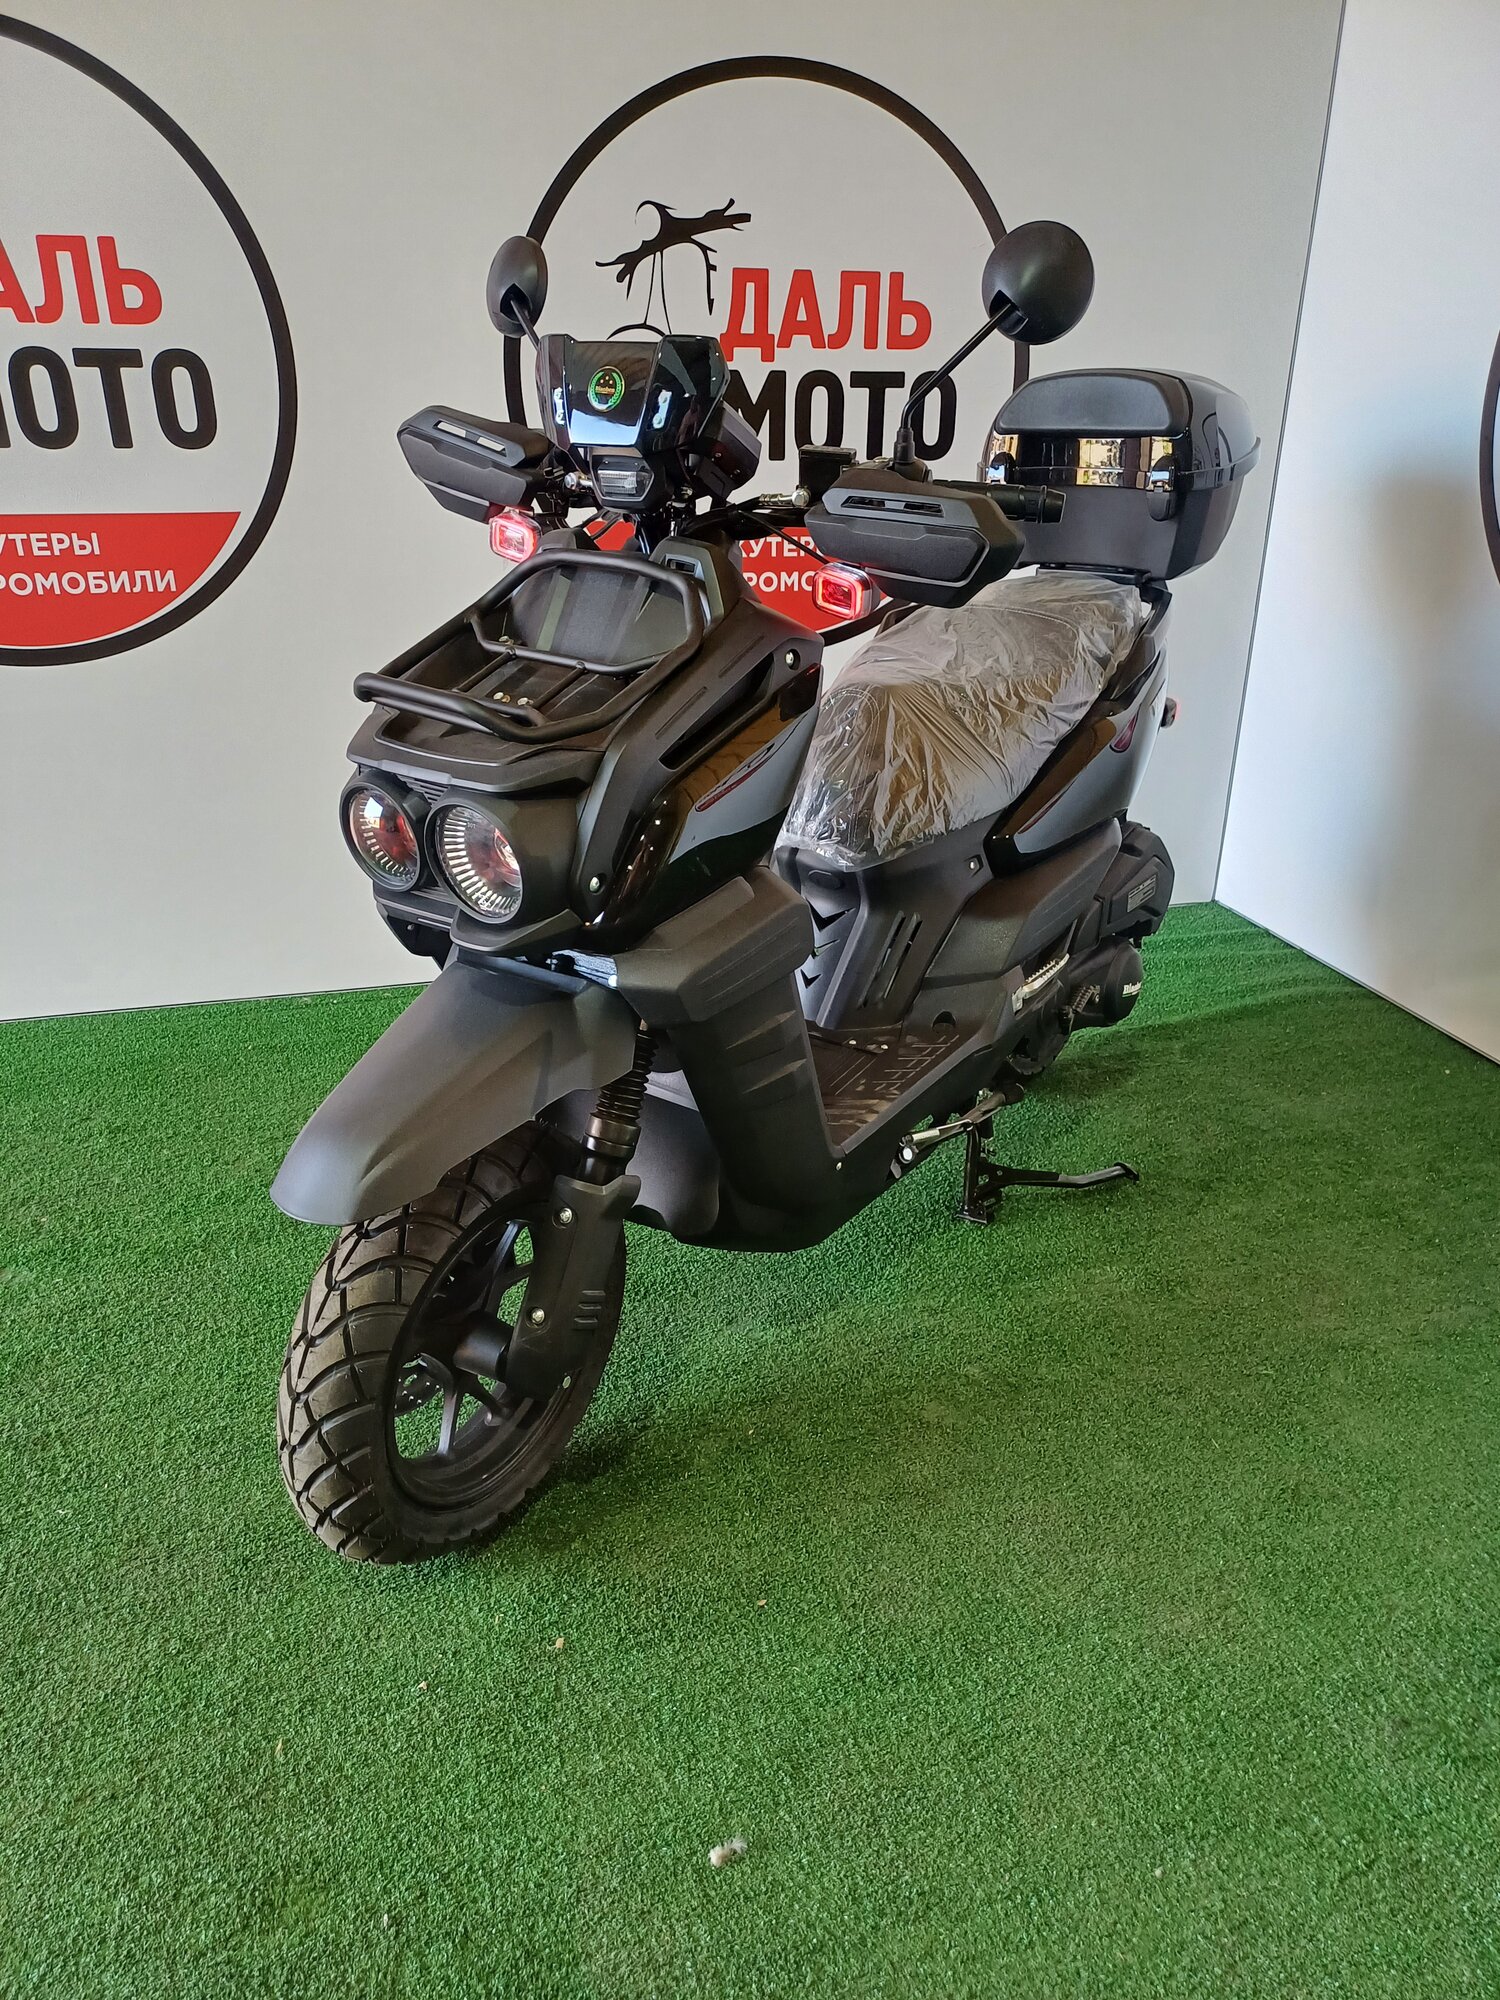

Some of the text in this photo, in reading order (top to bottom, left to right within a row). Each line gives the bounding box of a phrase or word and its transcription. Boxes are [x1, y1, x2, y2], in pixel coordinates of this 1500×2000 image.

[720, 267, 932, 362] ДАЛЬ
[0, 346, 217, 449] ОТО
[723, 369, 958, 461] МОТО
